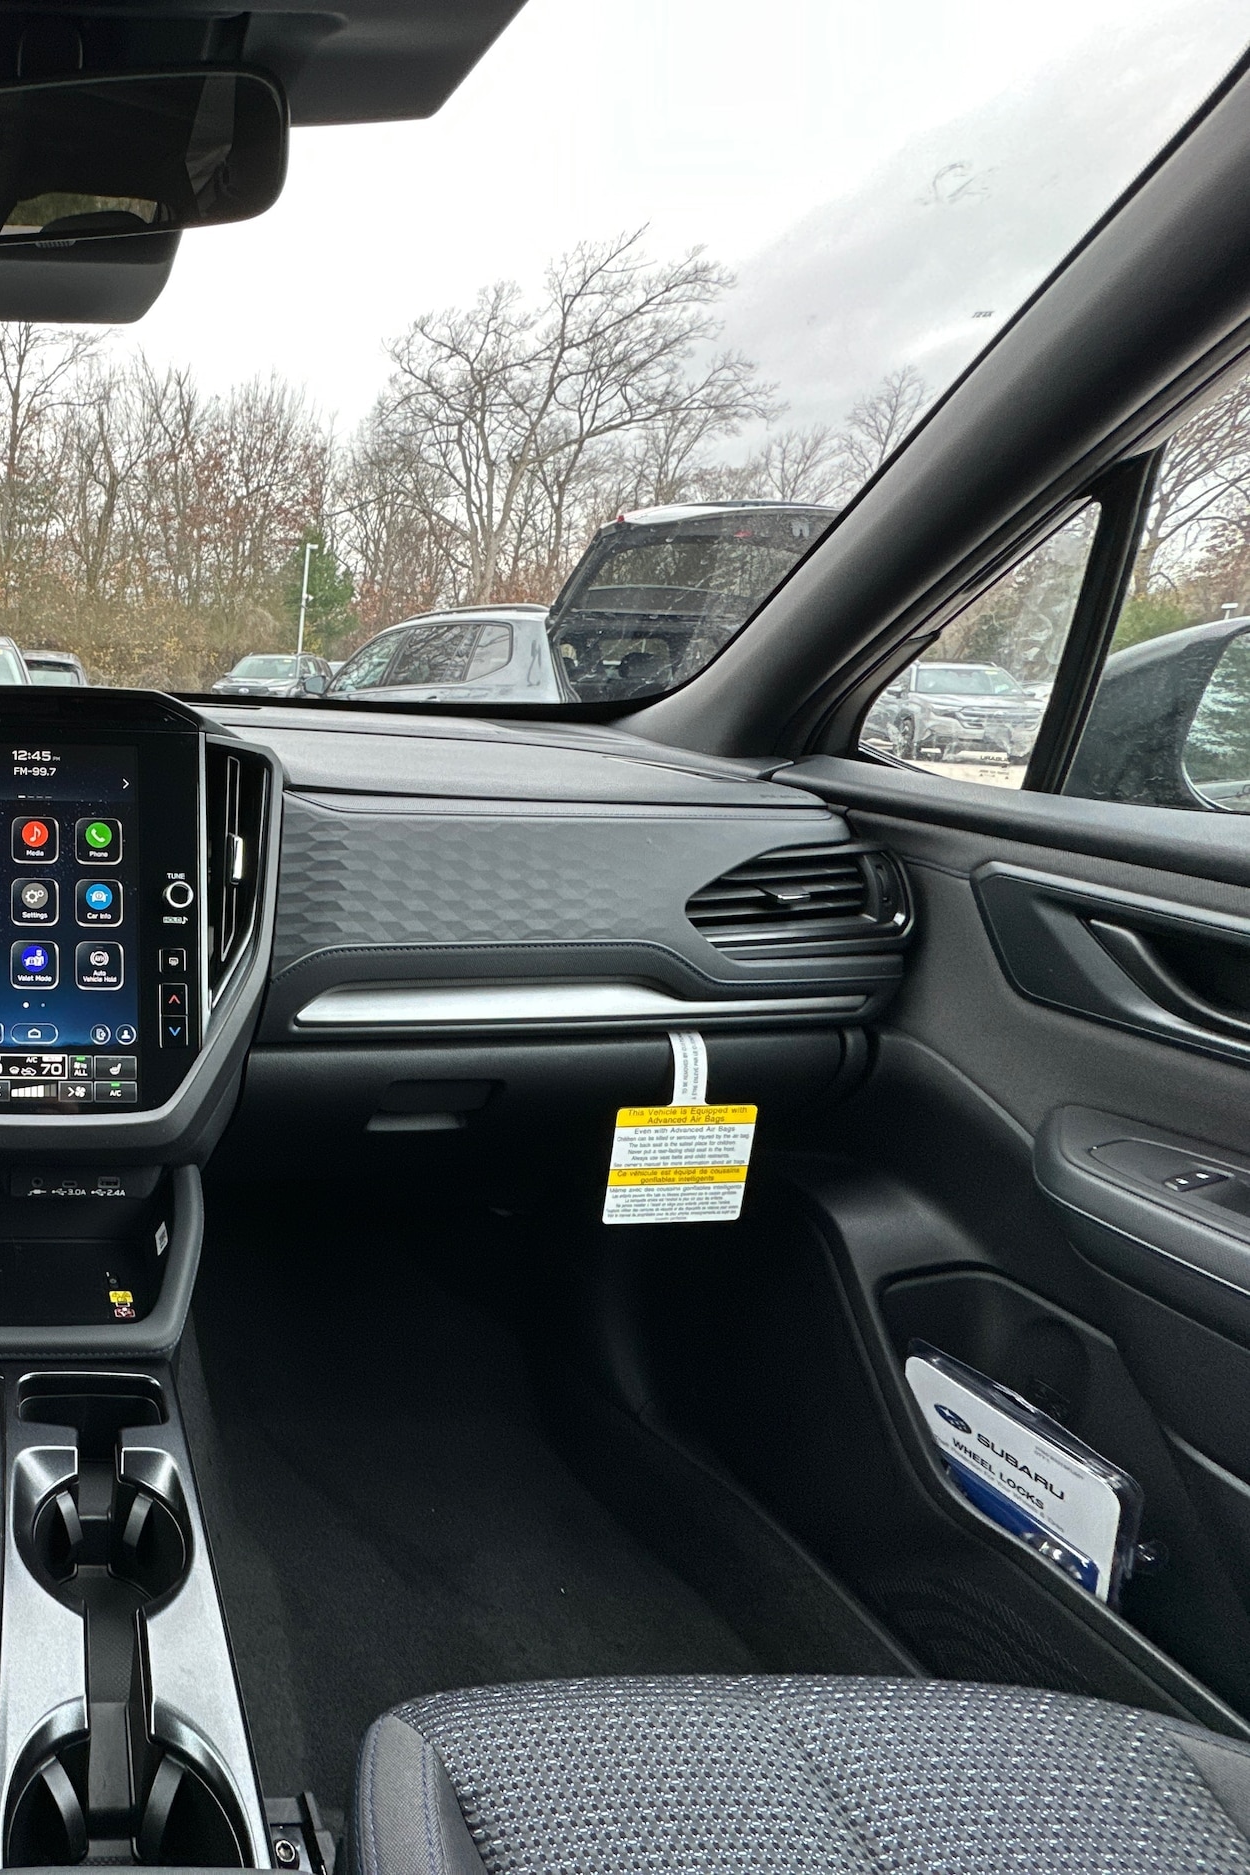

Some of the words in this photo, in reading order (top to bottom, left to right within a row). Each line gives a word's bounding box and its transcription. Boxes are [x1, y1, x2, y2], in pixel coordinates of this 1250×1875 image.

[12, 750, 51, 761] 12:45
[13, 767, 57, 776] FM-99.7
[166, 872, 185, 880] TUNE
[22, 912, 48, 920] Settings
[87, 912, 98, 920] Car
[17, 974, 34, 982] Valet
[35, 974, 52, 982] Mode
[40, 1063, 62, 1076] 70
[648, 1108, 678, 1116] Vehicle
[690, 1106, 728, 1116] Equipped
[732, 1106, 748, 1114] with
[648, 1116, 687, 1124] Advanced
[704, 1115, 725, 1124] Bags
[670, 1126, 704, 1134] Advanced
[640, 1176, 675, 1184] gonflables
[678, 1175, 714, 1183] intelligents
[66, 1188, 86, 1196] 3.0A
[977, 1433, 1065, 1501] SUBARU
[953, 1438, 996, 1476] WHEEL
[999, 1472, 1045, 1511] LOCKS
